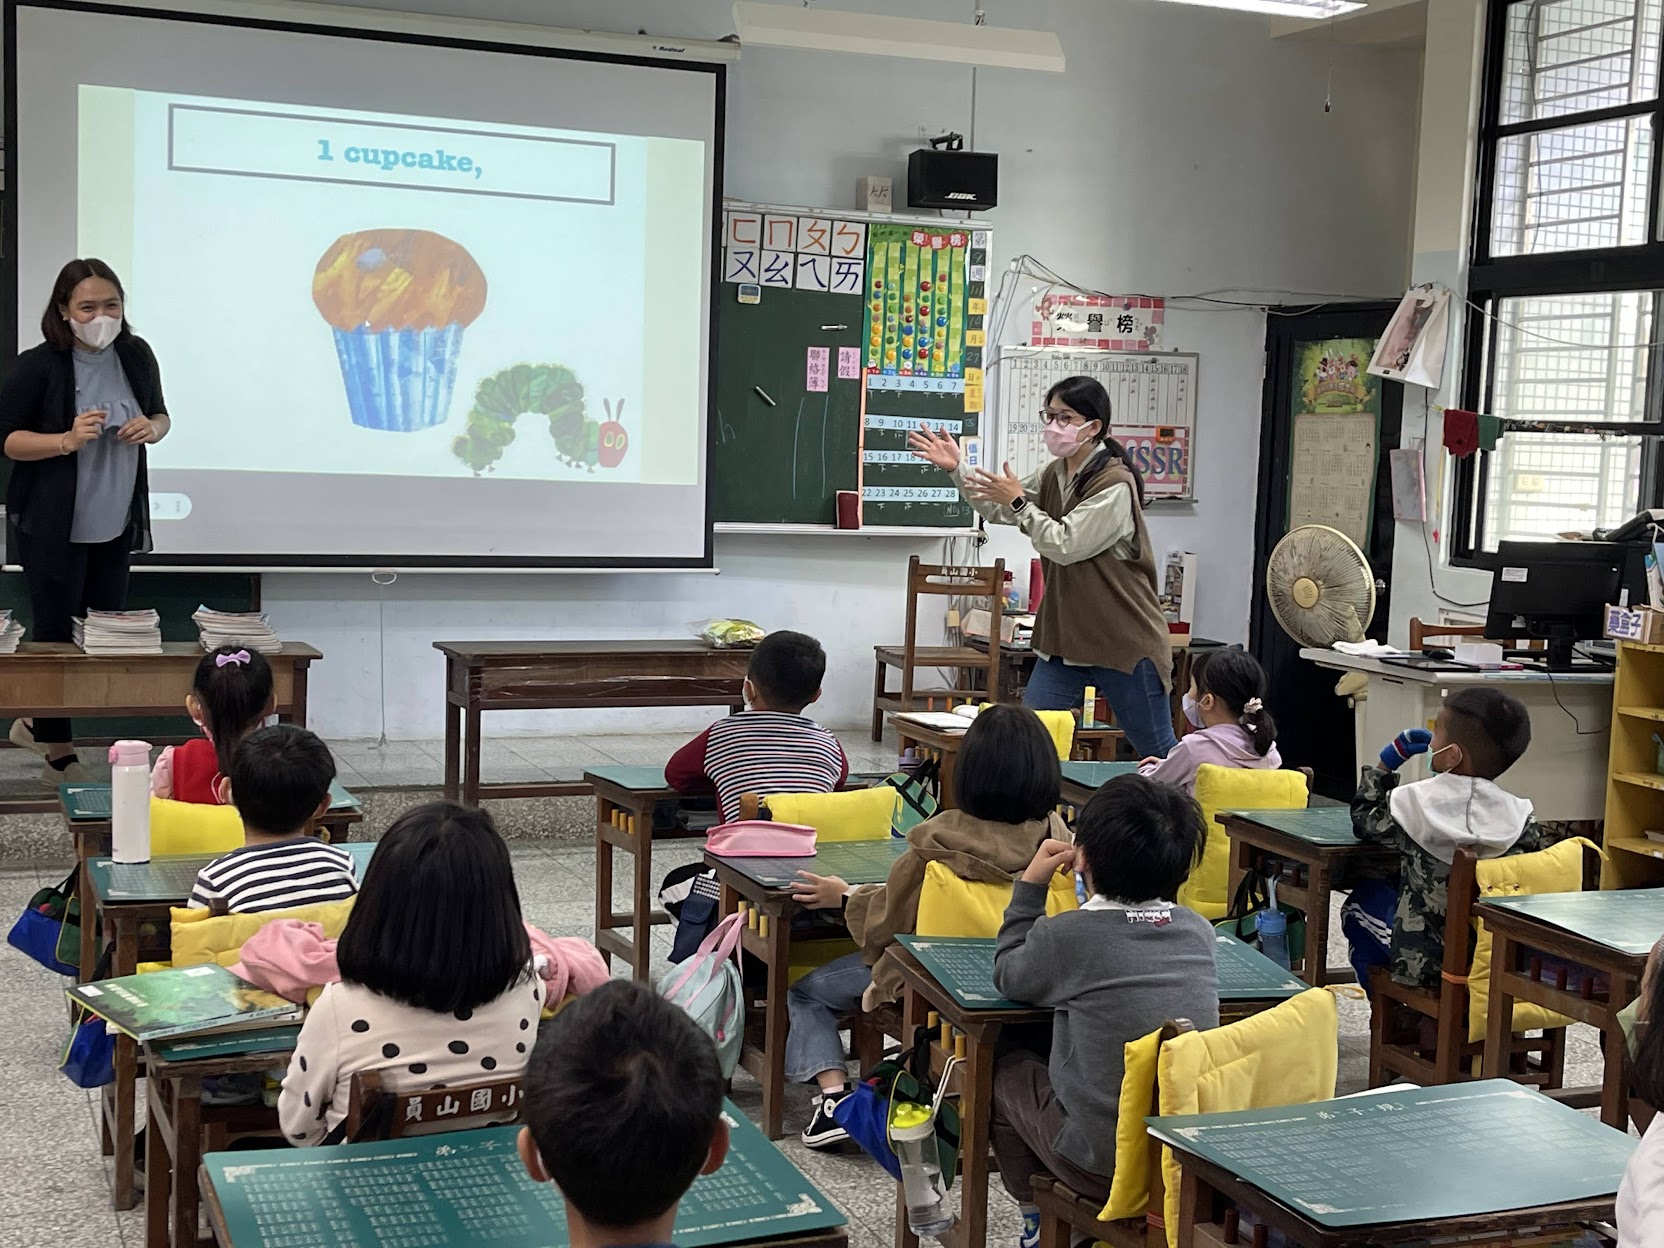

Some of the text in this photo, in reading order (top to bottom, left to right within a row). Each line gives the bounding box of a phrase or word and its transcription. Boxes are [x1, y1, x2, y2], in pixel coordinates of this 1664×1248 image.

[318, 139, 482, 180] 1 cupcake,
[405, 1084, 524, 1122] 員山國小
